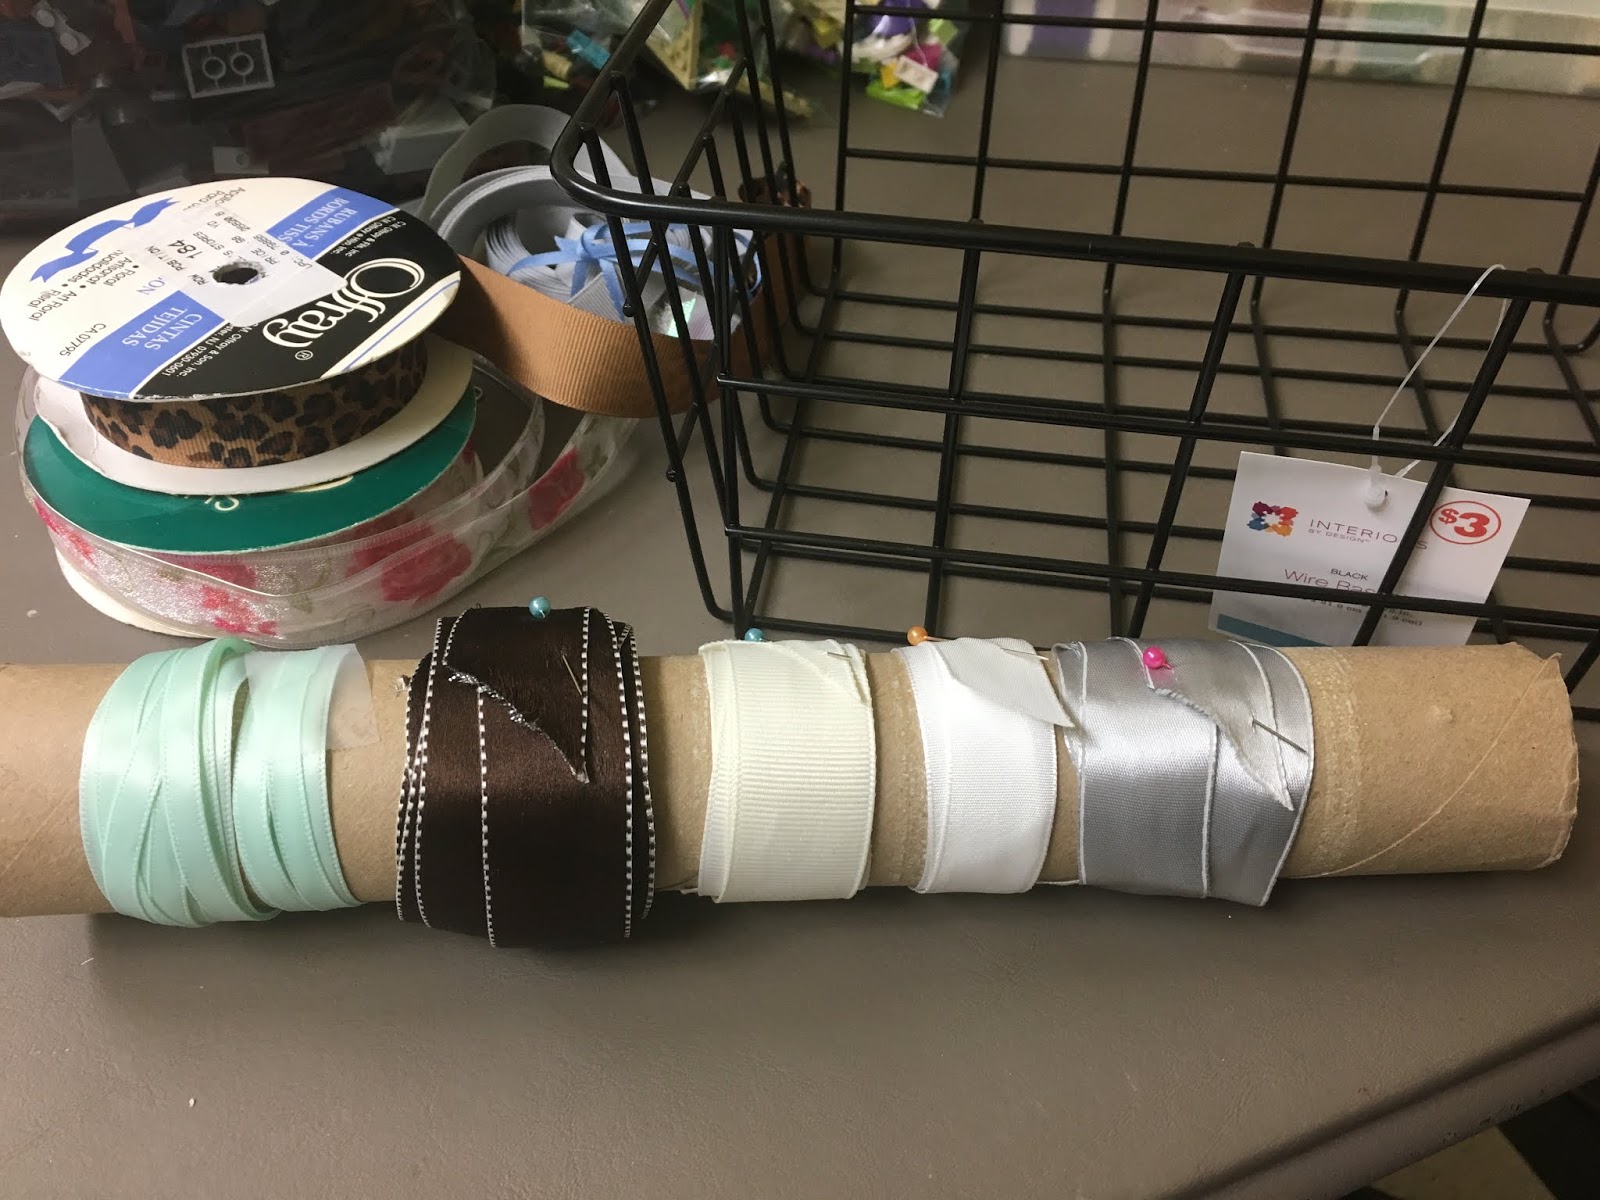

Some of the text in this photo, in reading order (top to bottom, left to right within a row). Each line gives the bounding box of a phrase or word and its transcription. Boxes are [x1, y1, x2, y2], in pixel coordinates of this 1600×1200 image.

[278, 198, 350, 242] BORDS TISS
[304, 208, 358, 240] RUBANS
[169, 239, 203, 259] 184
[193, 231, 225, 251] STORES
[68, 250, 123, 282] nualidades
[251, 248, 280, 265] PRICE
[104, 269, 136, 286] Floral
[137, 277, 165, 295] ON
[190, 274, 209, 286] ROW
[29, 301, 62, 321] Floral
[262, 257, 425, 350] Offray
[122, 307, 188, 346] TEJIDAS
[145, 314, 202, 350] CINTAS
[216, 334, 241, 350] Offray
[1438, 508, 1490, 538] $3
[1310, 519, 1428, 549] INTERIOS
[1285, 569, 1328, 588] Wire
[1331, 568, 1368, 581] BLACK
